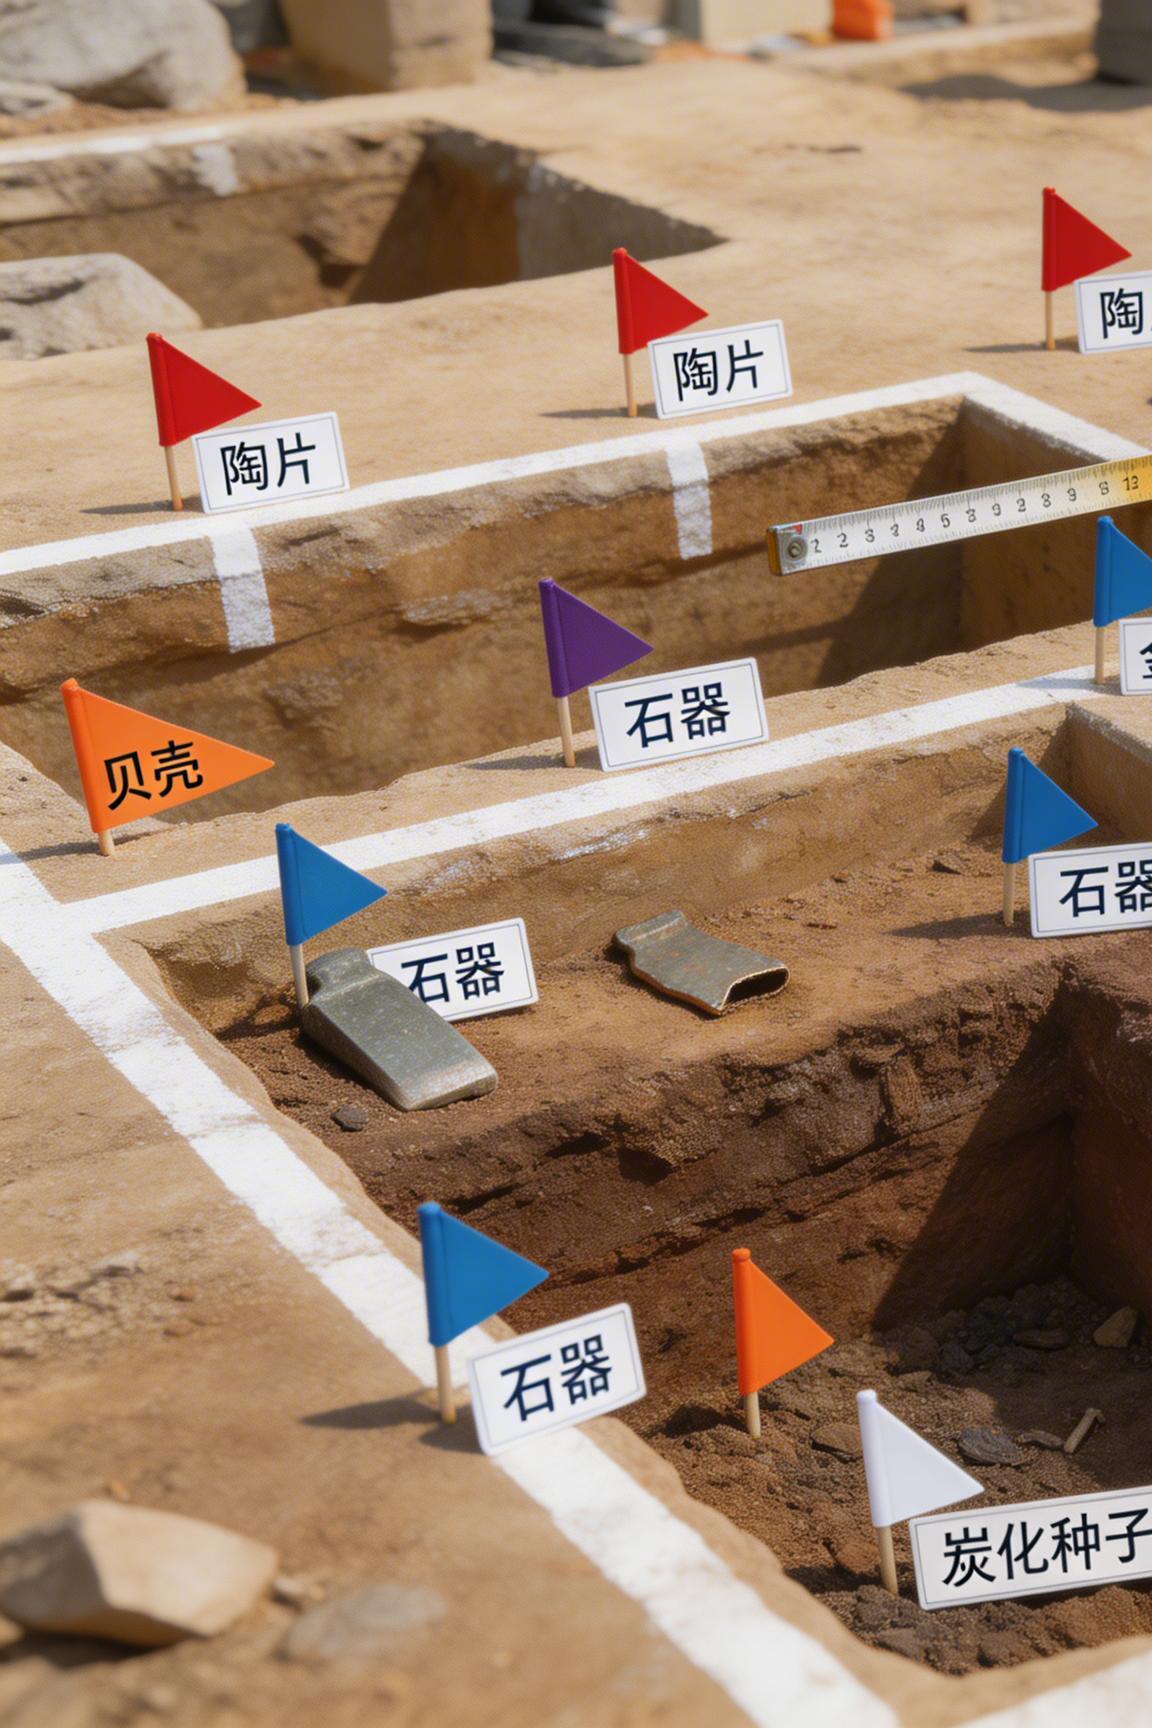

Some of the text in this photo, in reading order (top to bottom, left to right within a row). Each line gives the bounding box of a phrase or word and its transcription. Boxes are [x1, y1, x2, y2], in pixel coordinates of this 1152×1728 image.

[673, 341, 764, 402] 陶片
[220, 432, 316, 496] 陶片
[624, 682, 730, 748] 石器
[103, 740, 204, 811] 贝壳
[401, 942, 504, 1003] 石器
[500, 1333, 613, 1422] 石器
